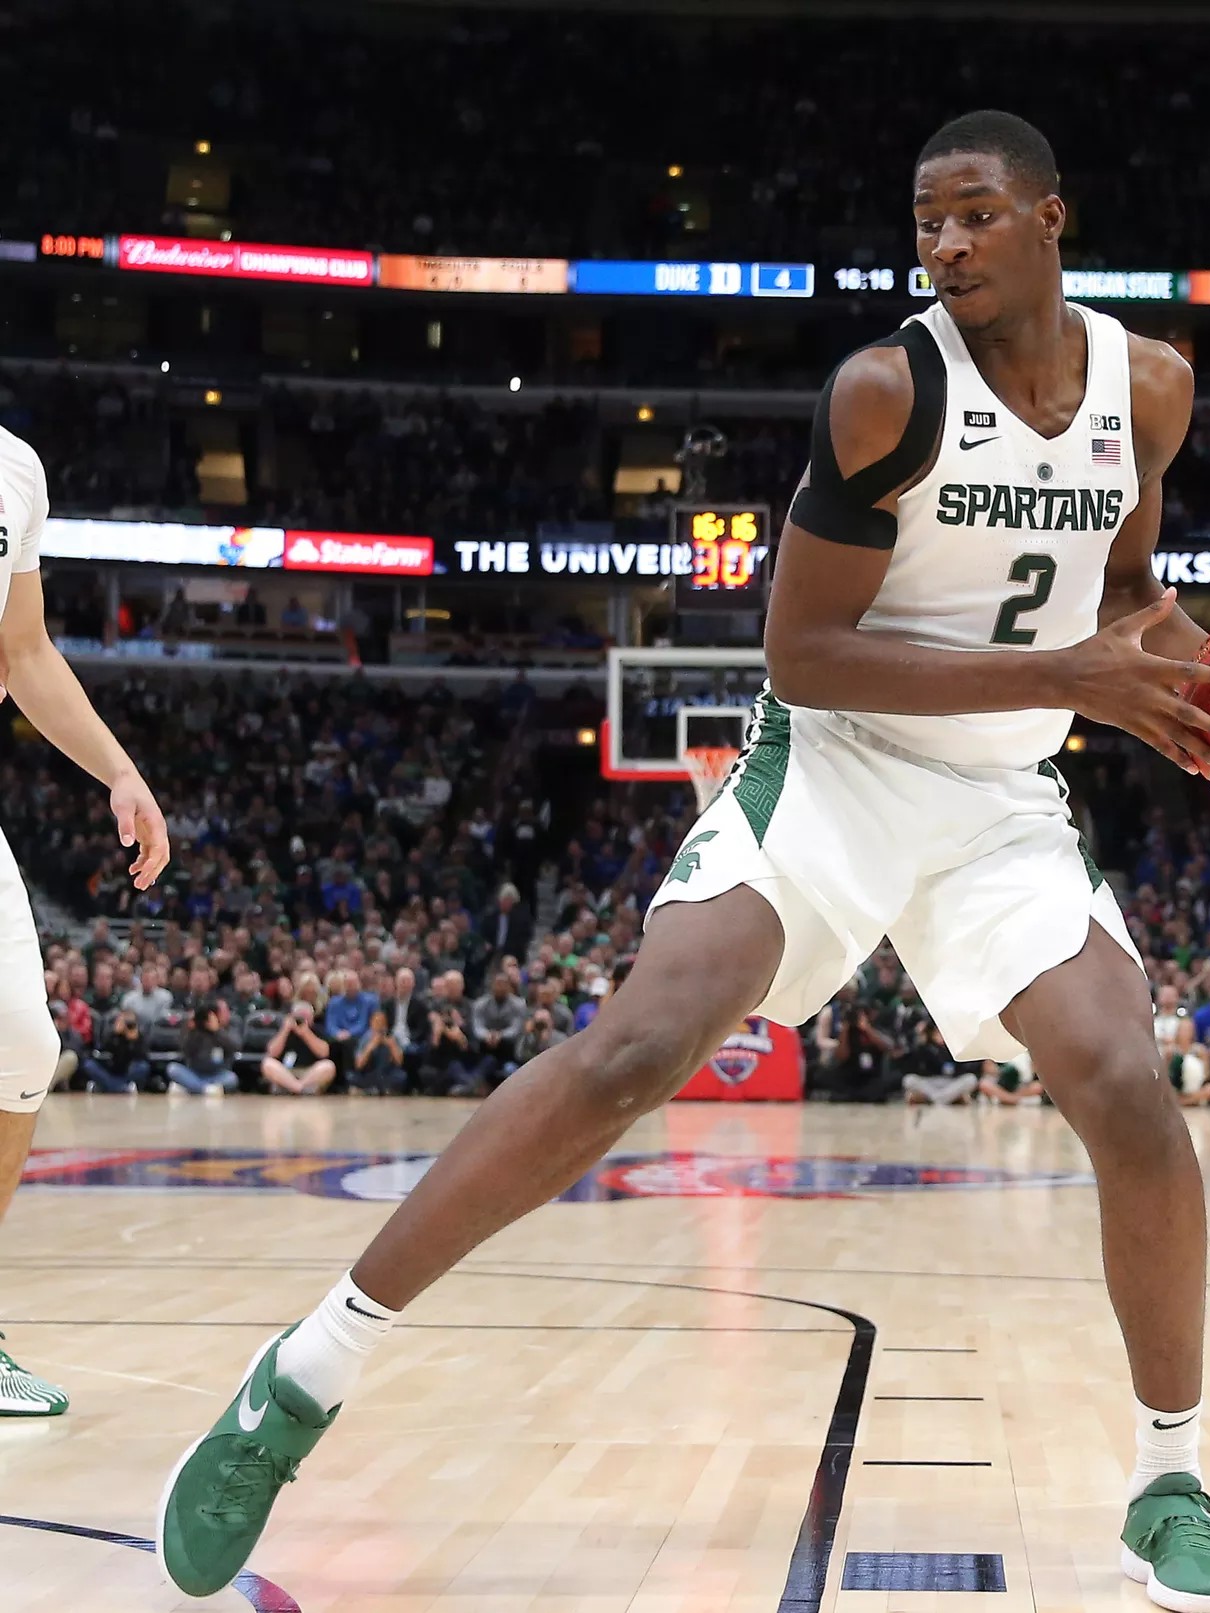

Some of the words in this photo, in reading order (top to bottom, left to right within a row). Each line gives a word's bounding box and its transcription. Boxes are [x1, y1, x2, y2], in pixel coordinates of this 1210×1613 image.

[123, 238, 233, 269] Budweiser
[655, 263, 700, 291] DUKE
[774, 268, 792, 290] 4
[969, 413, 991, 426] JUD
[936, 483, 1123, 531] SPARTANS
[454, 541, 530, 572] THE
[989, 552, 1057, 645] 2
